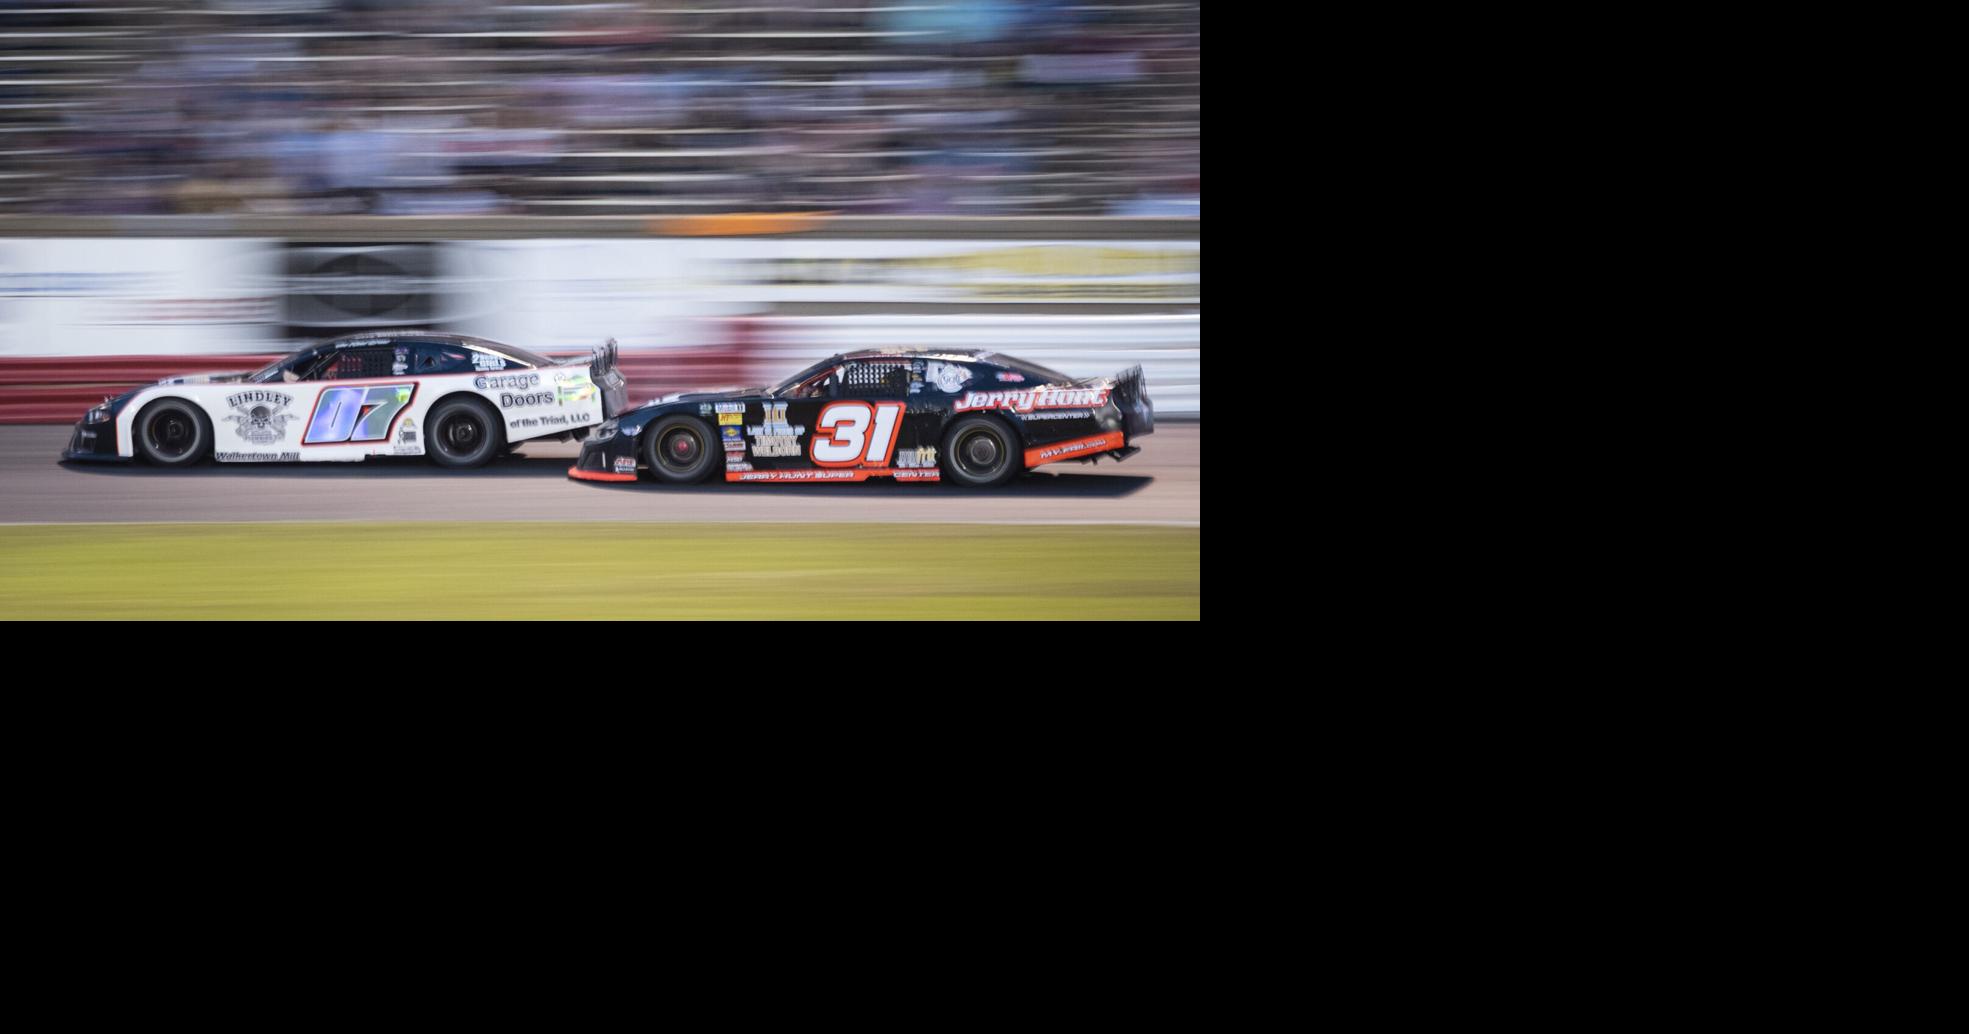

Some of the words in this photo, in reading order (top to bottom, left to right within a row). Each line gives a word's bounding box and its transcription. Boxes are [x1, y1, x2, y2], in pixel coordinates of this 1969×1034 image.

[474, 373, 540, 390] Garage
[226, 391, 294, 408] LINDLEY
[501, 392, 554, 408] Doors
[303, 383, 418, 444] 07
[522, 418, 538, 427] the
[540, 415, 569, 426] Triad,
[571, 413, 590, 423] LLC
[811, 402, 905, 466] 31
[216, 452, 277, 460] Walkertown
[279, 452, 300, 460] Mill
[740, 471, 777, 480] JERRY
[894, 470, 940, 478] CENTER
